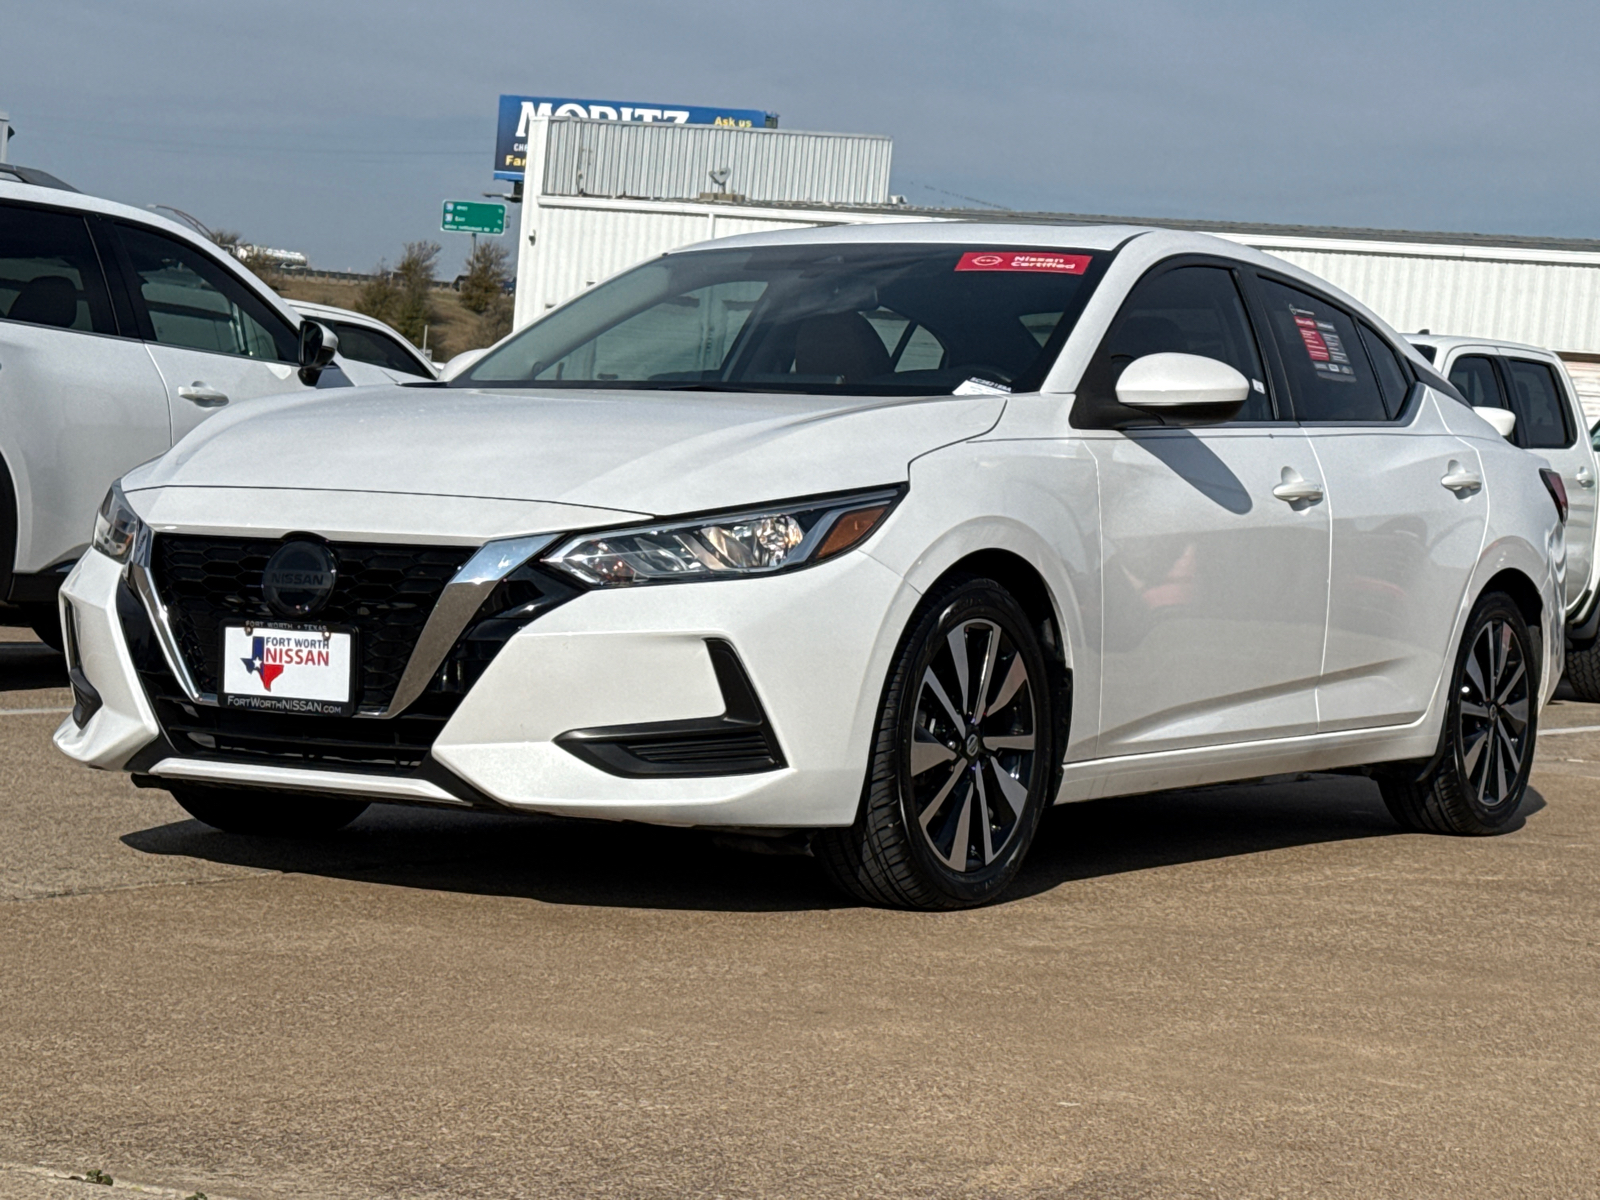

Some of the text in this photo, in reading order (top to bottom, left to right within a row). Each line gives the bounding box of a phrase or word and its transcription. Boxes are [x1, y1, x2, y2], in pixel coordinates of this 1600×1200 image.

[714, 116, 752, 128] Ask us
[271, 573, 324, 585] NISSAN
[245, 620, 327, 631] FORT WORTH TEXAS
[265, 636, 330, 649] FORT WORTH
[265, 647, 329, 666] NISSAN
